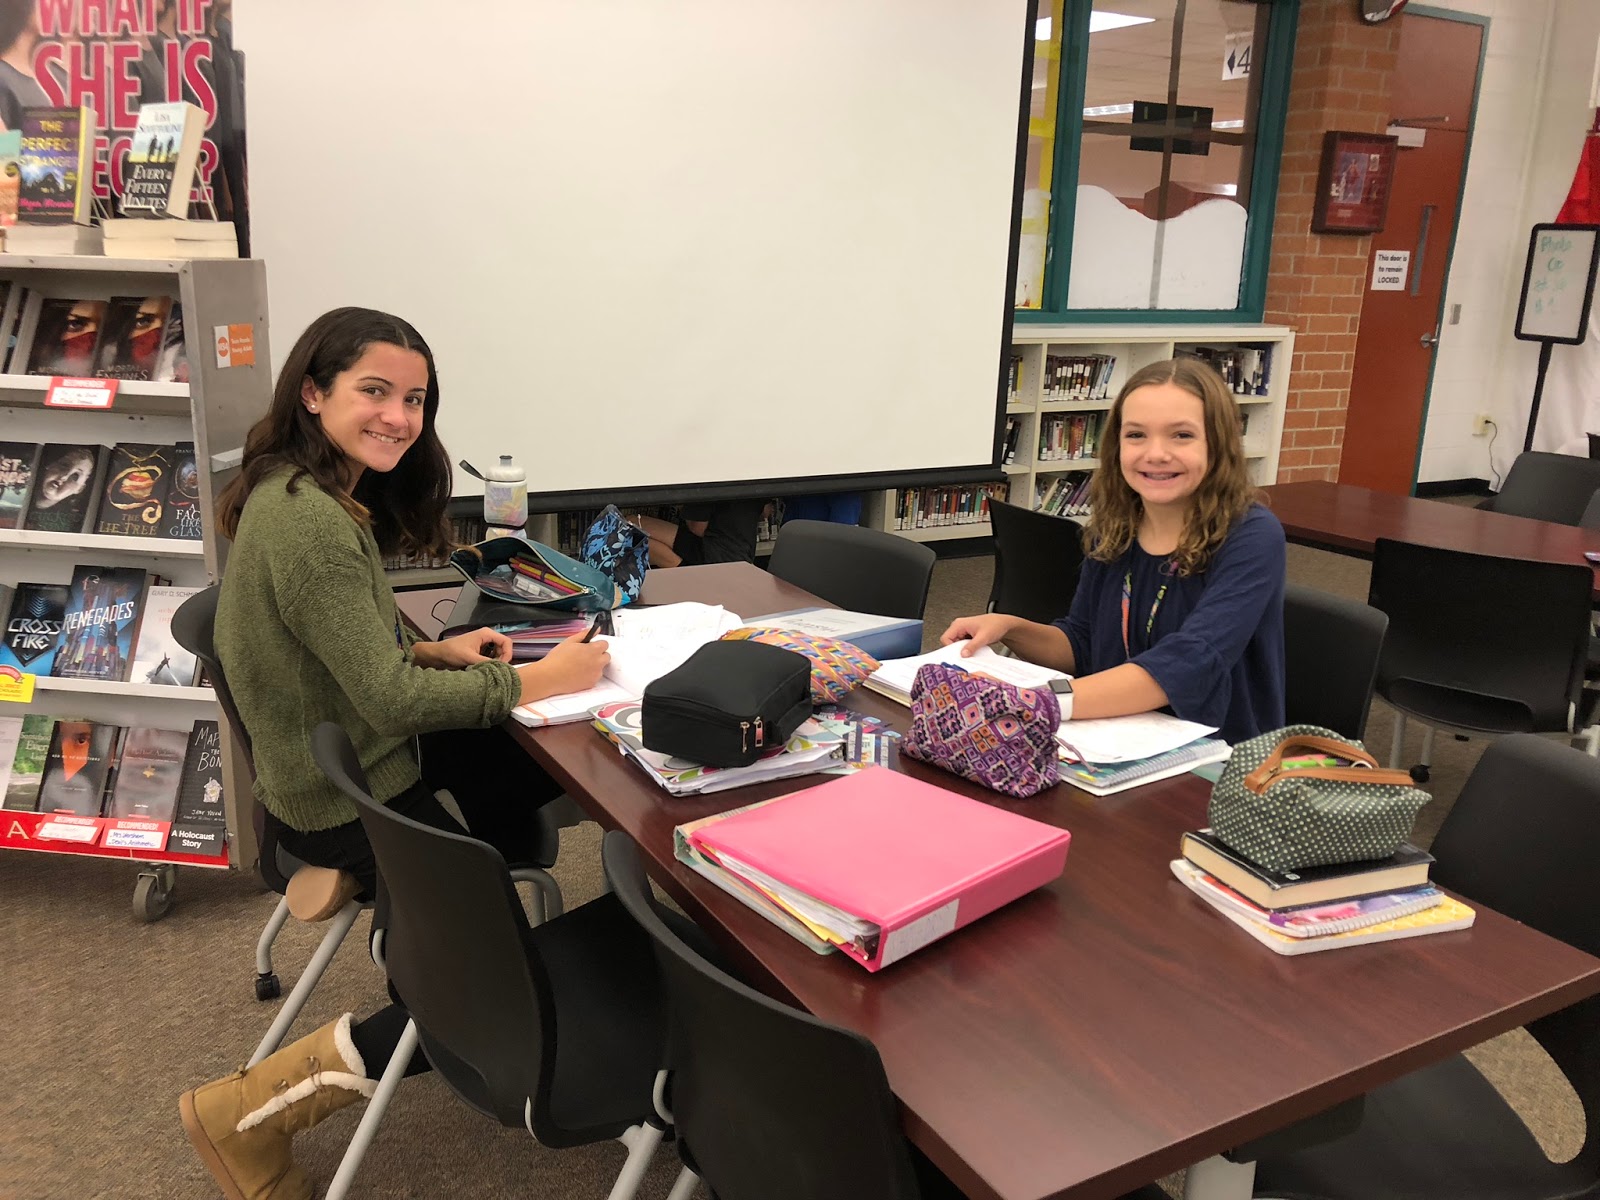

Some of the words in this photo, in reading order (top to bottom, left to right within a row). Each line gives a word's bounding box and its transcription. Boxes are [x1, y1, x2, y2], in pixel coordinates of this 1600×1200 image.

[1237, 45, 1251, 74] 4
[33, 41, 142, 130] SHE
[164, 39, 218, 131] IS
[39, 120, 64, 132] THE
[133, 164, 164, 179] EVERY
[124, 179, 167, 194] FIFTEEN
[120, 193, 167, 209] MINUTES
[1377, 276, 1400, 284] LOCKED
[176, 508, 200, 520] FAC
[99, 520, 121, 534] LIE
[124, 518, 158, 535] TREE
[169, 525, 203, 537] GLAS
[62, 601, 135, 635] RENEGADES
[8, 618, 62, 635] CROSS
[12, 633, 51, 650] FIRE
[194, 726, 221, 749] MAP
[197, 752, 222, 771] BON
[117, 821, 159, 831] RECOMMENDED!
[179, 831, 215, 840] Holocaust
[182, 839, 202, 849] Story
